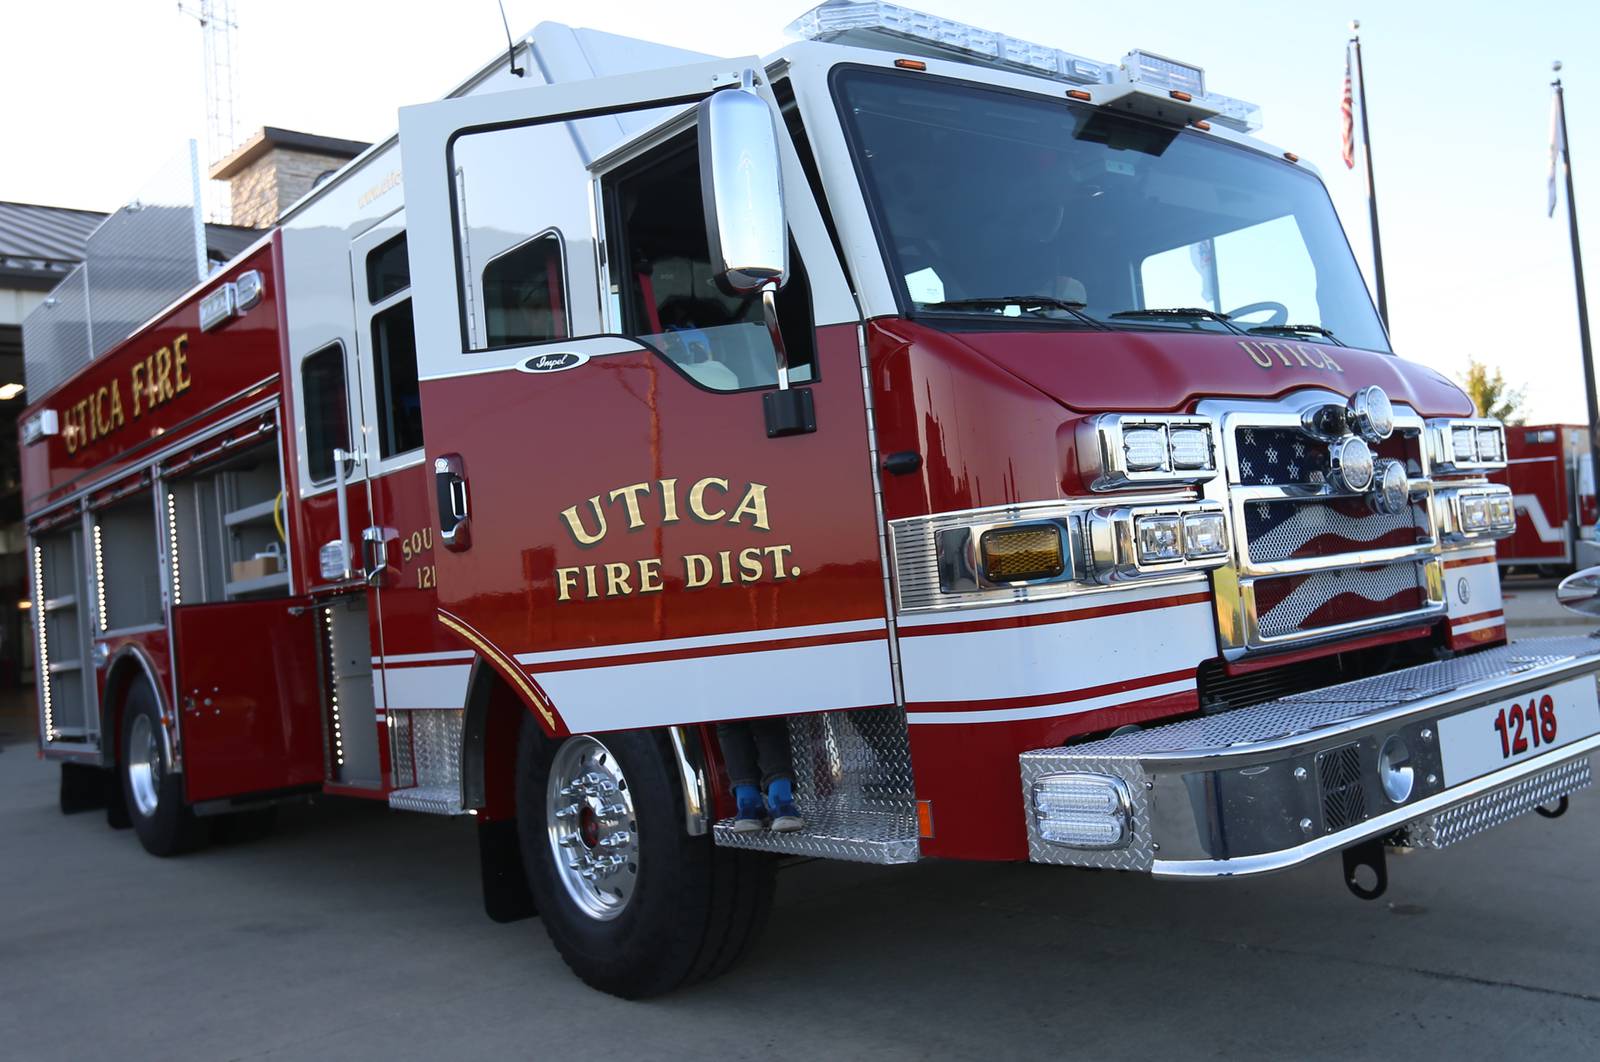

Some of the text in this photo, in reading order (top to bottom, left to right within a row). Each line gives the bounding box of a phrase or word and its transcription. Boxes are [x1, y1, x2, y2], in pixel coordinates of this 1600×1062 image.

[536, 354, 568, 369] Impel
[1238, 341, 1344, 372] UTICA
[63, 333, 192, 454] UTICA FIRE
[561, 477, 771, 544] UTICA
[556, 544, 801, 601] FIRE DIST.
[1494, 694, 1557, 760] 1218
